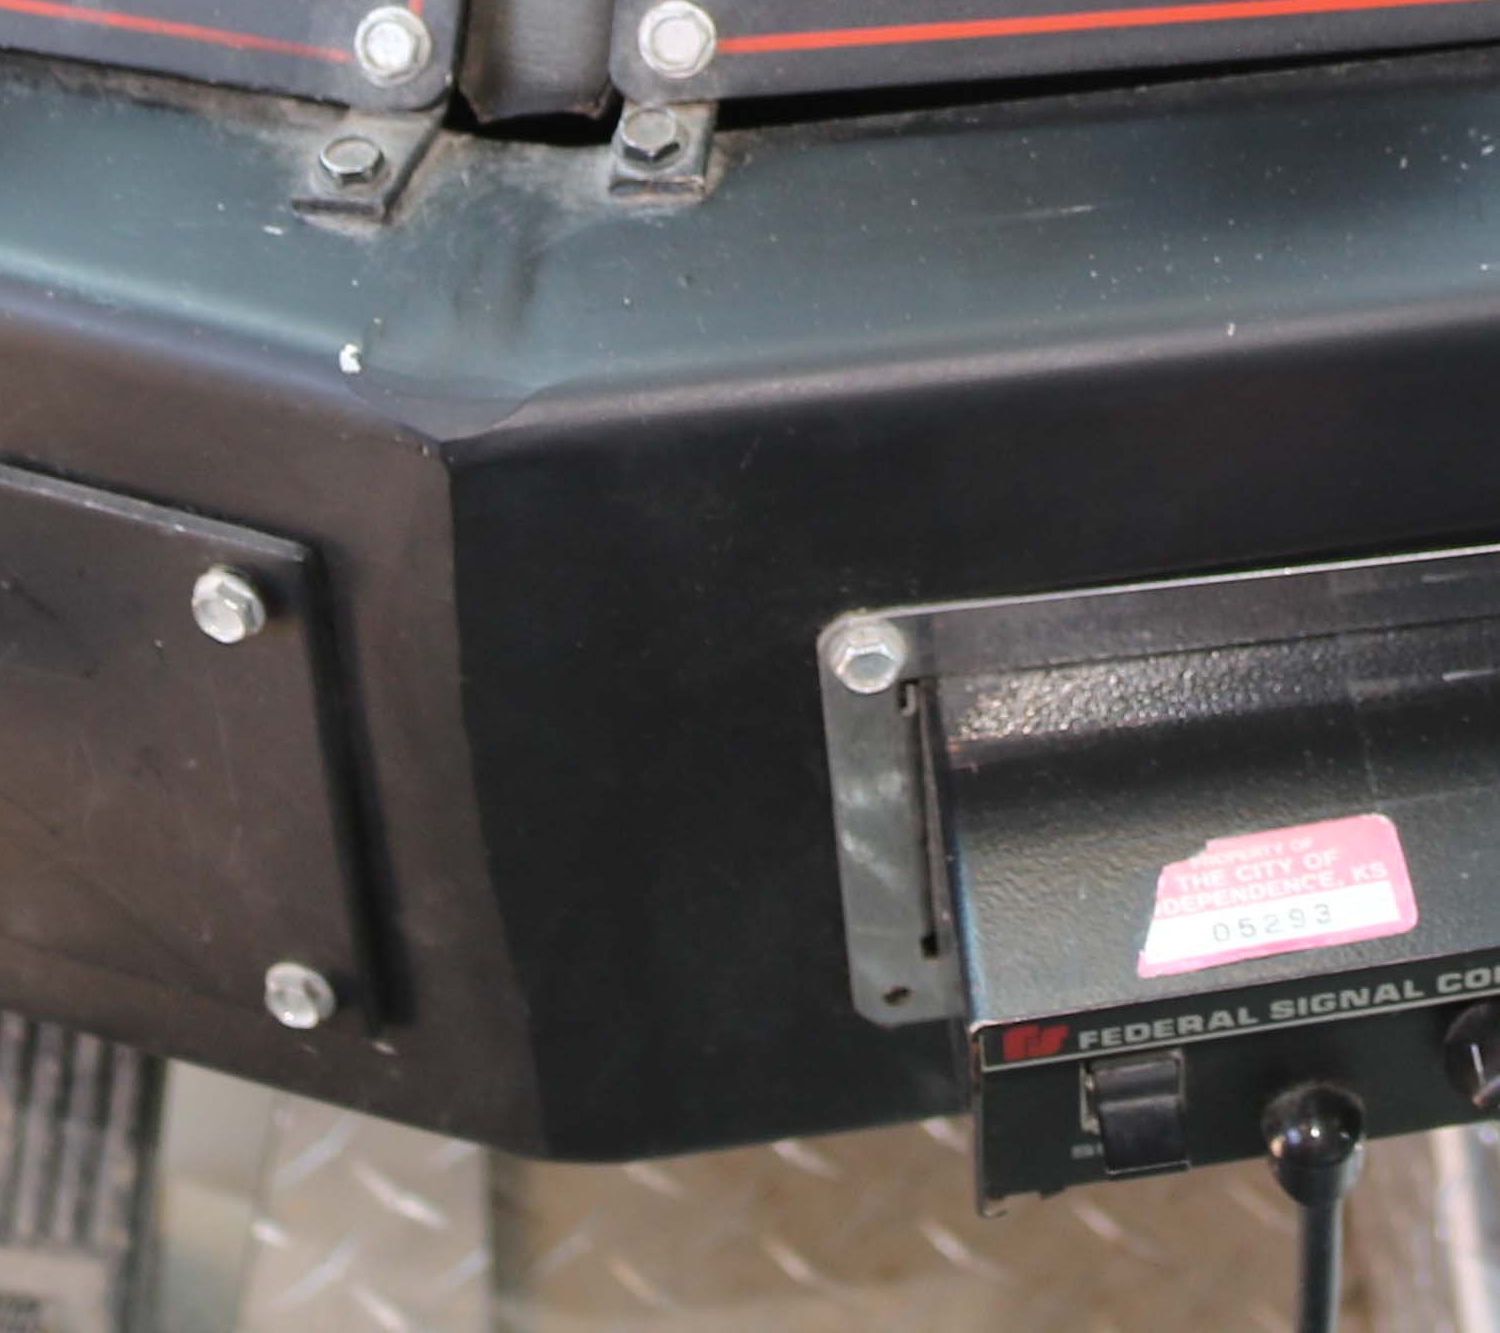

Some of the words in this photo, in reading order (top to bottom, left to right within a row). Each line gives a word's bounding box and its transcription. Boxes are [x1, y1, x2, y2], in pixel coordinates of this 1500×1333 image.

[1175, 868, 1227, 894] THE
[1234, 856, 1295, 883] CITY
[1302, 847, 1341, 871] OF
[1351, 860, 1389, 883] KS
[1211, 903, 1333, 943] 05293
[1078, 1005, 1260, 1051] FEDERAL
[1269, 979, 1425, 1020] SIGNAL
